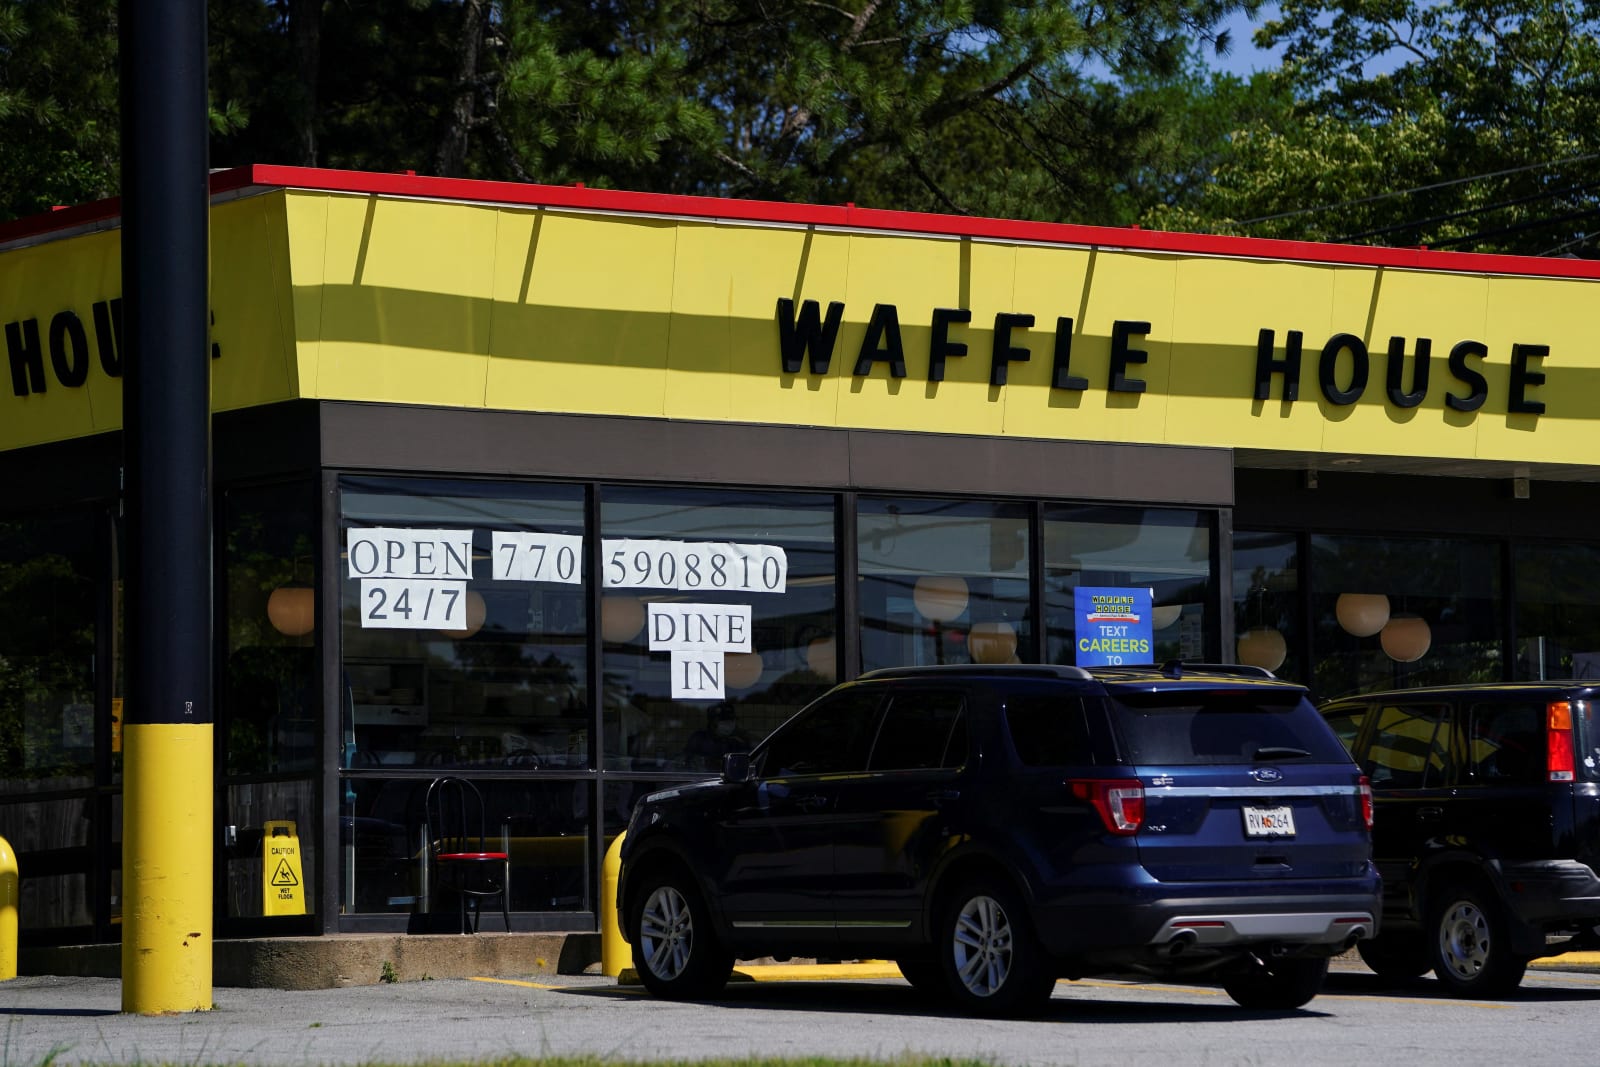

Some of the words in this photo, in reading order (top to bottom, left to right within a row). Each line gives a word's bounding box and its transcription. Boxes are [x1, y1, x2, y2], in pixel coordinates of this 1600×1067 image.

[777, 297, 1152, 393] WAFFLE
[1254, 328, 1550, 415] HOUSE
[350, 539, 471, 577] OPEN
[500, 543, 575, 580] 770
[610, 551, 781, 589] 5908810
[368, 587, 460, 621] 24/7
[1092, 595, 1134, 604] WAFFLE
[1096, 604, 1131, 613] HOUSE
[652, 613, 746, 644] DINE
[1099, 625, 1128, 637] TEXT
[1079, 638, 1149, 653] CAREERS
[1106, 655, 1123, 666] TO
[681, 661, 721, 691] IN
[271, 847, 295, 855] CAUTION
